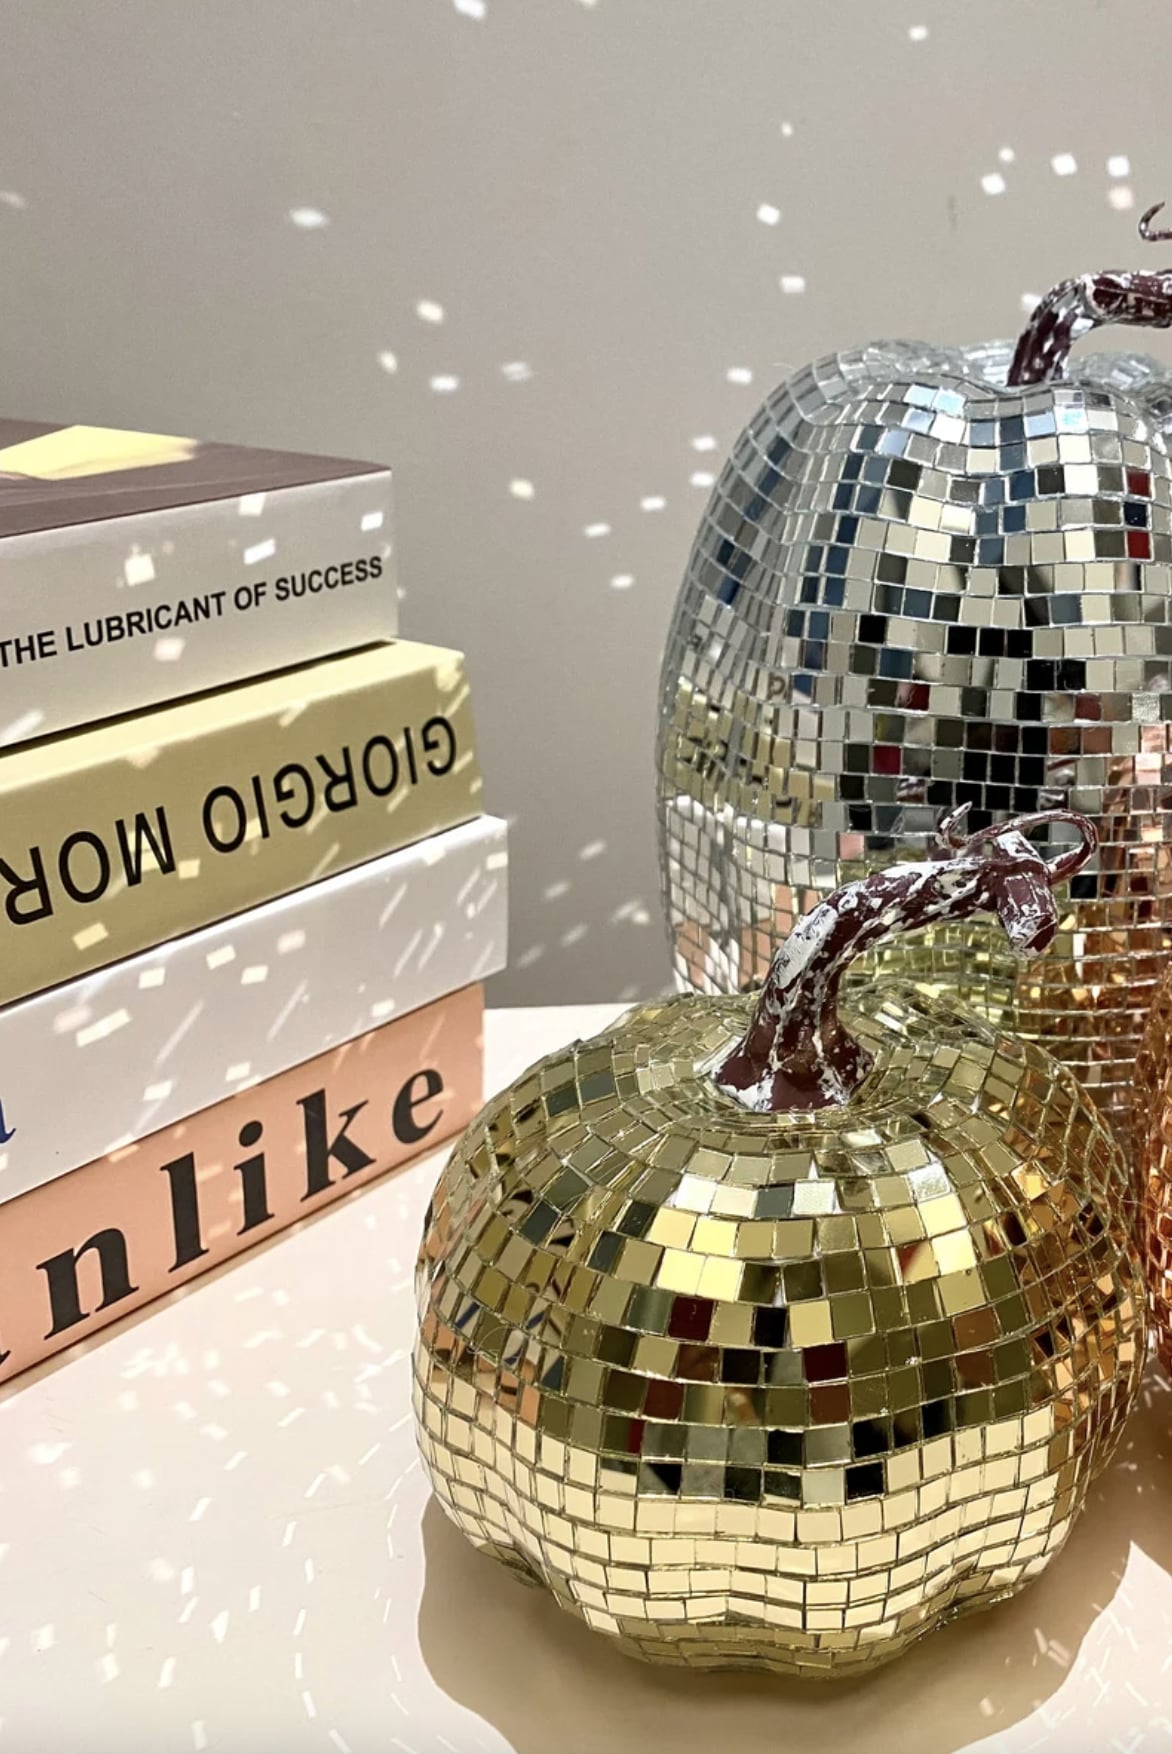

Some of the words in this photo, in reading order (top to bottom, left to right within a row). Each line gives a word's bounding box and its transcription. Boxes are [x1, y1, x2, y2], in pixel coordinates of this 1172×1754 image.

[0, 630, 57, 667] THE
[66, 591, 226, 651] LUBRICANT
[234, 582, 267, 611] OF
[275, 556, 383, 601] SUCCESS
[202, 716, 457, 853] GIORGIO
[0, 1067, 445, 1366] nlike
